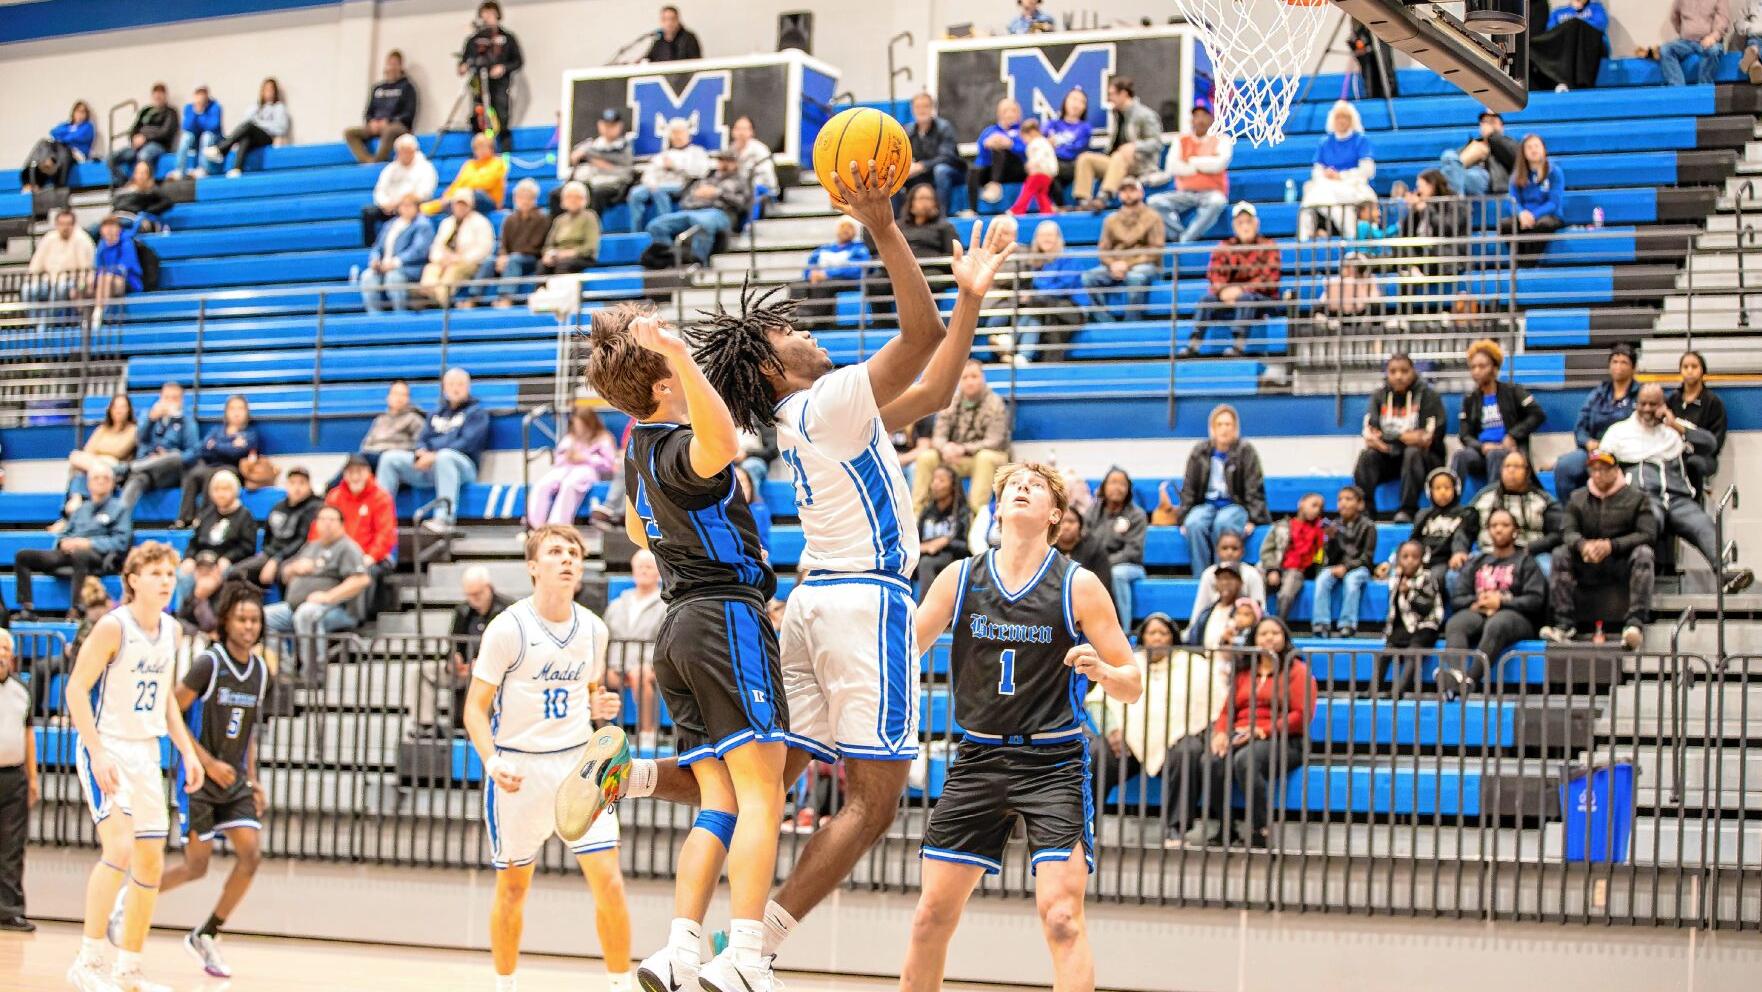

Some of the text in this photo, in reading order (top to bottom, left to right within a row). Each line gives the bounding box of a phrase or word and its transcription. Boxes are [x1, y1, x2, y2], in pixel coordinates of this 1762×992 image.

[1001, 43, 1116, 134] M
[626, 70, 732, 157] M
[970, 614, 1053, 643] Bremen
[532, 661, 585, 681] Model
[998, 649, 1016, 695] 1
[134, 680, 158, 712] 23
[543, 688, 569, 719] 10
